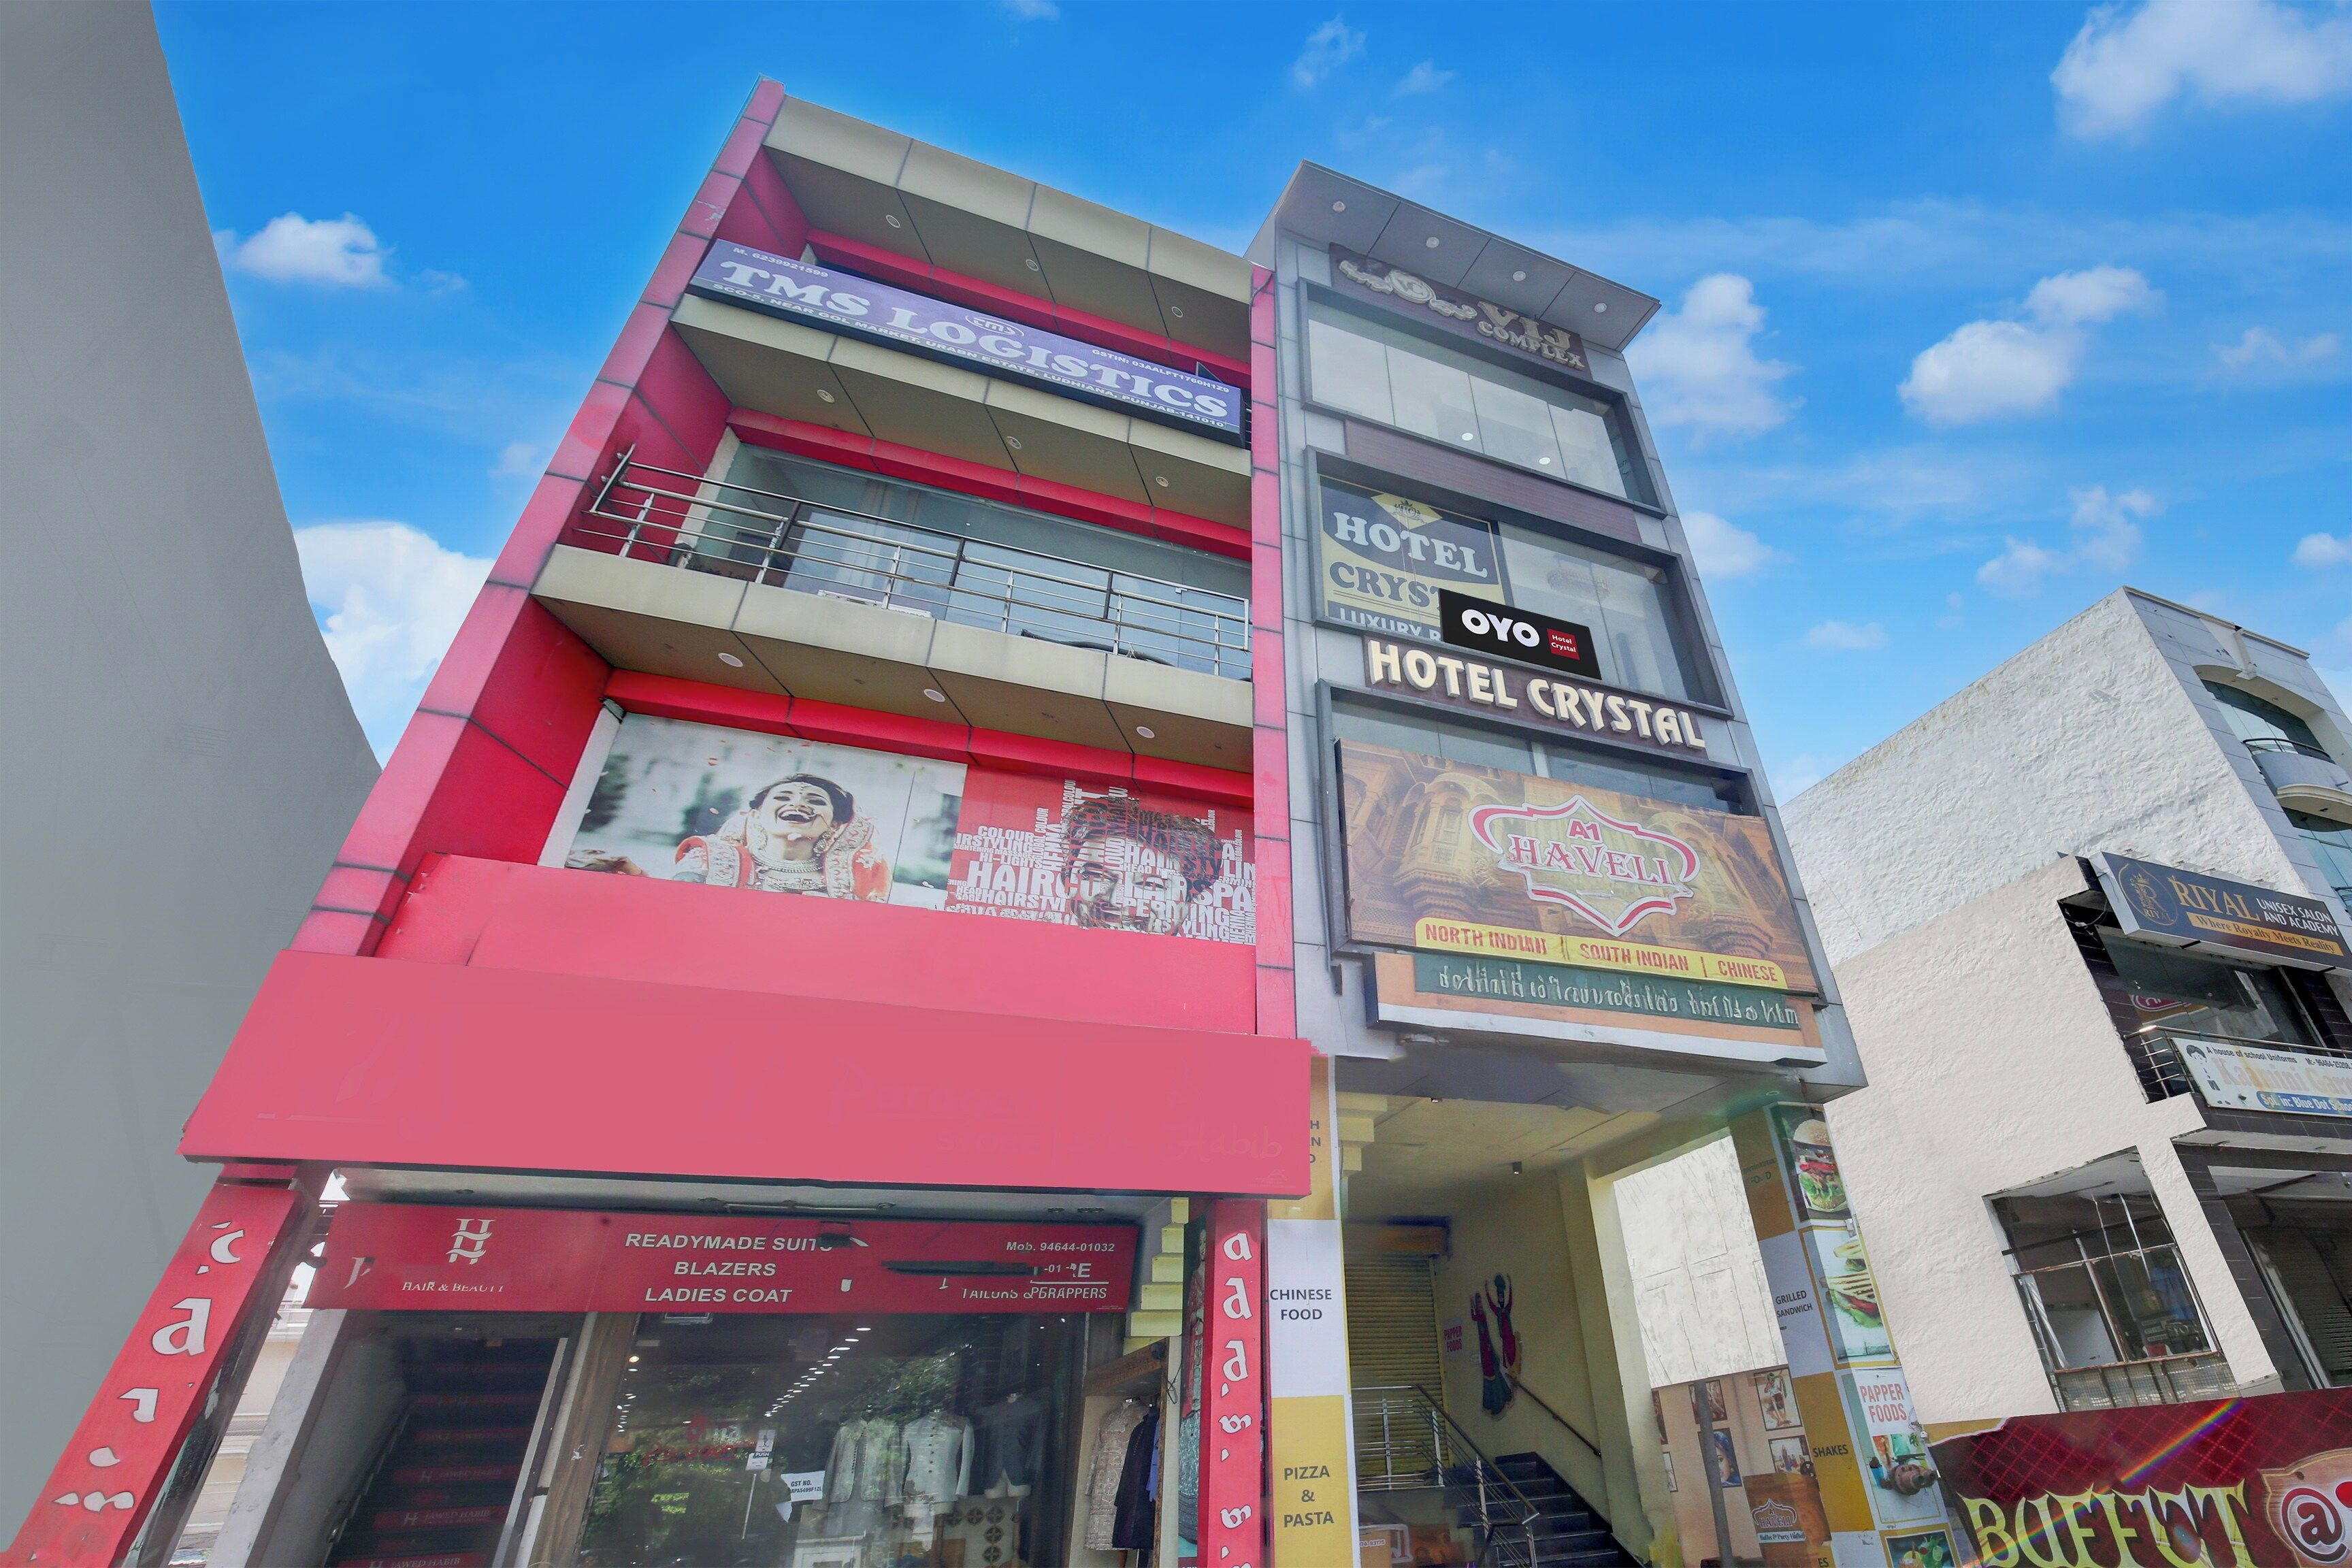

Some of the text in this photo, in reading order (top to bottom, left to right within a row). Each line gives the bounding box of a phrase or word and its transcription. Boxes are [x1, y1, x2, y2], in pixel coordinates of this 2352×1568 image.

[1477, 301, 1574, 352] VIJ
[720, 261, 1228, 417] TMS LOGISTICS
[1477, 321, 1585, 371] COMPLEX
[769, 299, 815, 314] NEAR
[818, 312, 851, 324] GOL
[1122, 395, 1224, 427] PUNJAB-141010
[1092, 349, 1130, 364] GSTIN:
[1334, 512, 1488, 578] HOTEL
[1339, 607, 1422, 638] LUXURY
[1461, 608, 1540, 647] OYO
[1551, 642, 1576, 653] Crystal
[1552, 634, 1572, 644] Hotel
[1368, 639, 1705, 749] HOTEL CRYSTAL
[978, 826, 1034, 843] COLOUR
[1569, 820, 1600, 840] A1
[979, 851, 1043, 869] HI-LIGHTS
[1512, 836, 1673, 884] HAVELI
[2170, 878, 2261, 921] RIYAL
[2256, 898, 2333, 924] UNISEX SALON
[2264, 911, 2339, 936] AND ACADEMY
[2196, 915, 2335, 953] Where Royalty Meets Reality
[1425, 924, 1484, 947] NORTH
[1579, 943, 1631, 964] SOUTH
[1635, 949, 1689, 971] INDIAN
[1717, 960, 1778, 982] CHINESE
[2214, 1047, 2234, 1058] house
[2236, 1049, 2243, 1058] of
[2244, 1051, 2266, 1060] school
[2267, 1054, 2298, 1063] Uniforms
[2293, 1096, 2314, 1109] Blue
[2315, 1098, 2331, 1111] Dot
[625, 1233, 766, 1250] READYMADE
[1007, 1241, 1115, 1252] Mob. 94644-01032
[674, 1261, 777, 1277] BLAZERS
[402, 1281, 435, 1292] HAIR
[1270, 1289, 1332, 1301] CHINESE
[644, 1288, 793, 1303] LADIES COAT
[1776, 1290, 1807, 1305] GRILLED
[1280, 1309, 1322, 1320] FOOD
[1776, 1303, 1813, 1318] SANDWICH
[1859, 1383, 1905, 1403] PAPPER
[1868, 1403, 1907, 1422] FOODS
[1813, 1444, 1848, 1458] SHAKES
[1284, 1465, 1330, 1480] PIZZA
[1301, 1490, 1315, 1503] &
[1284, 1512, 1334, 1528] PASTA
